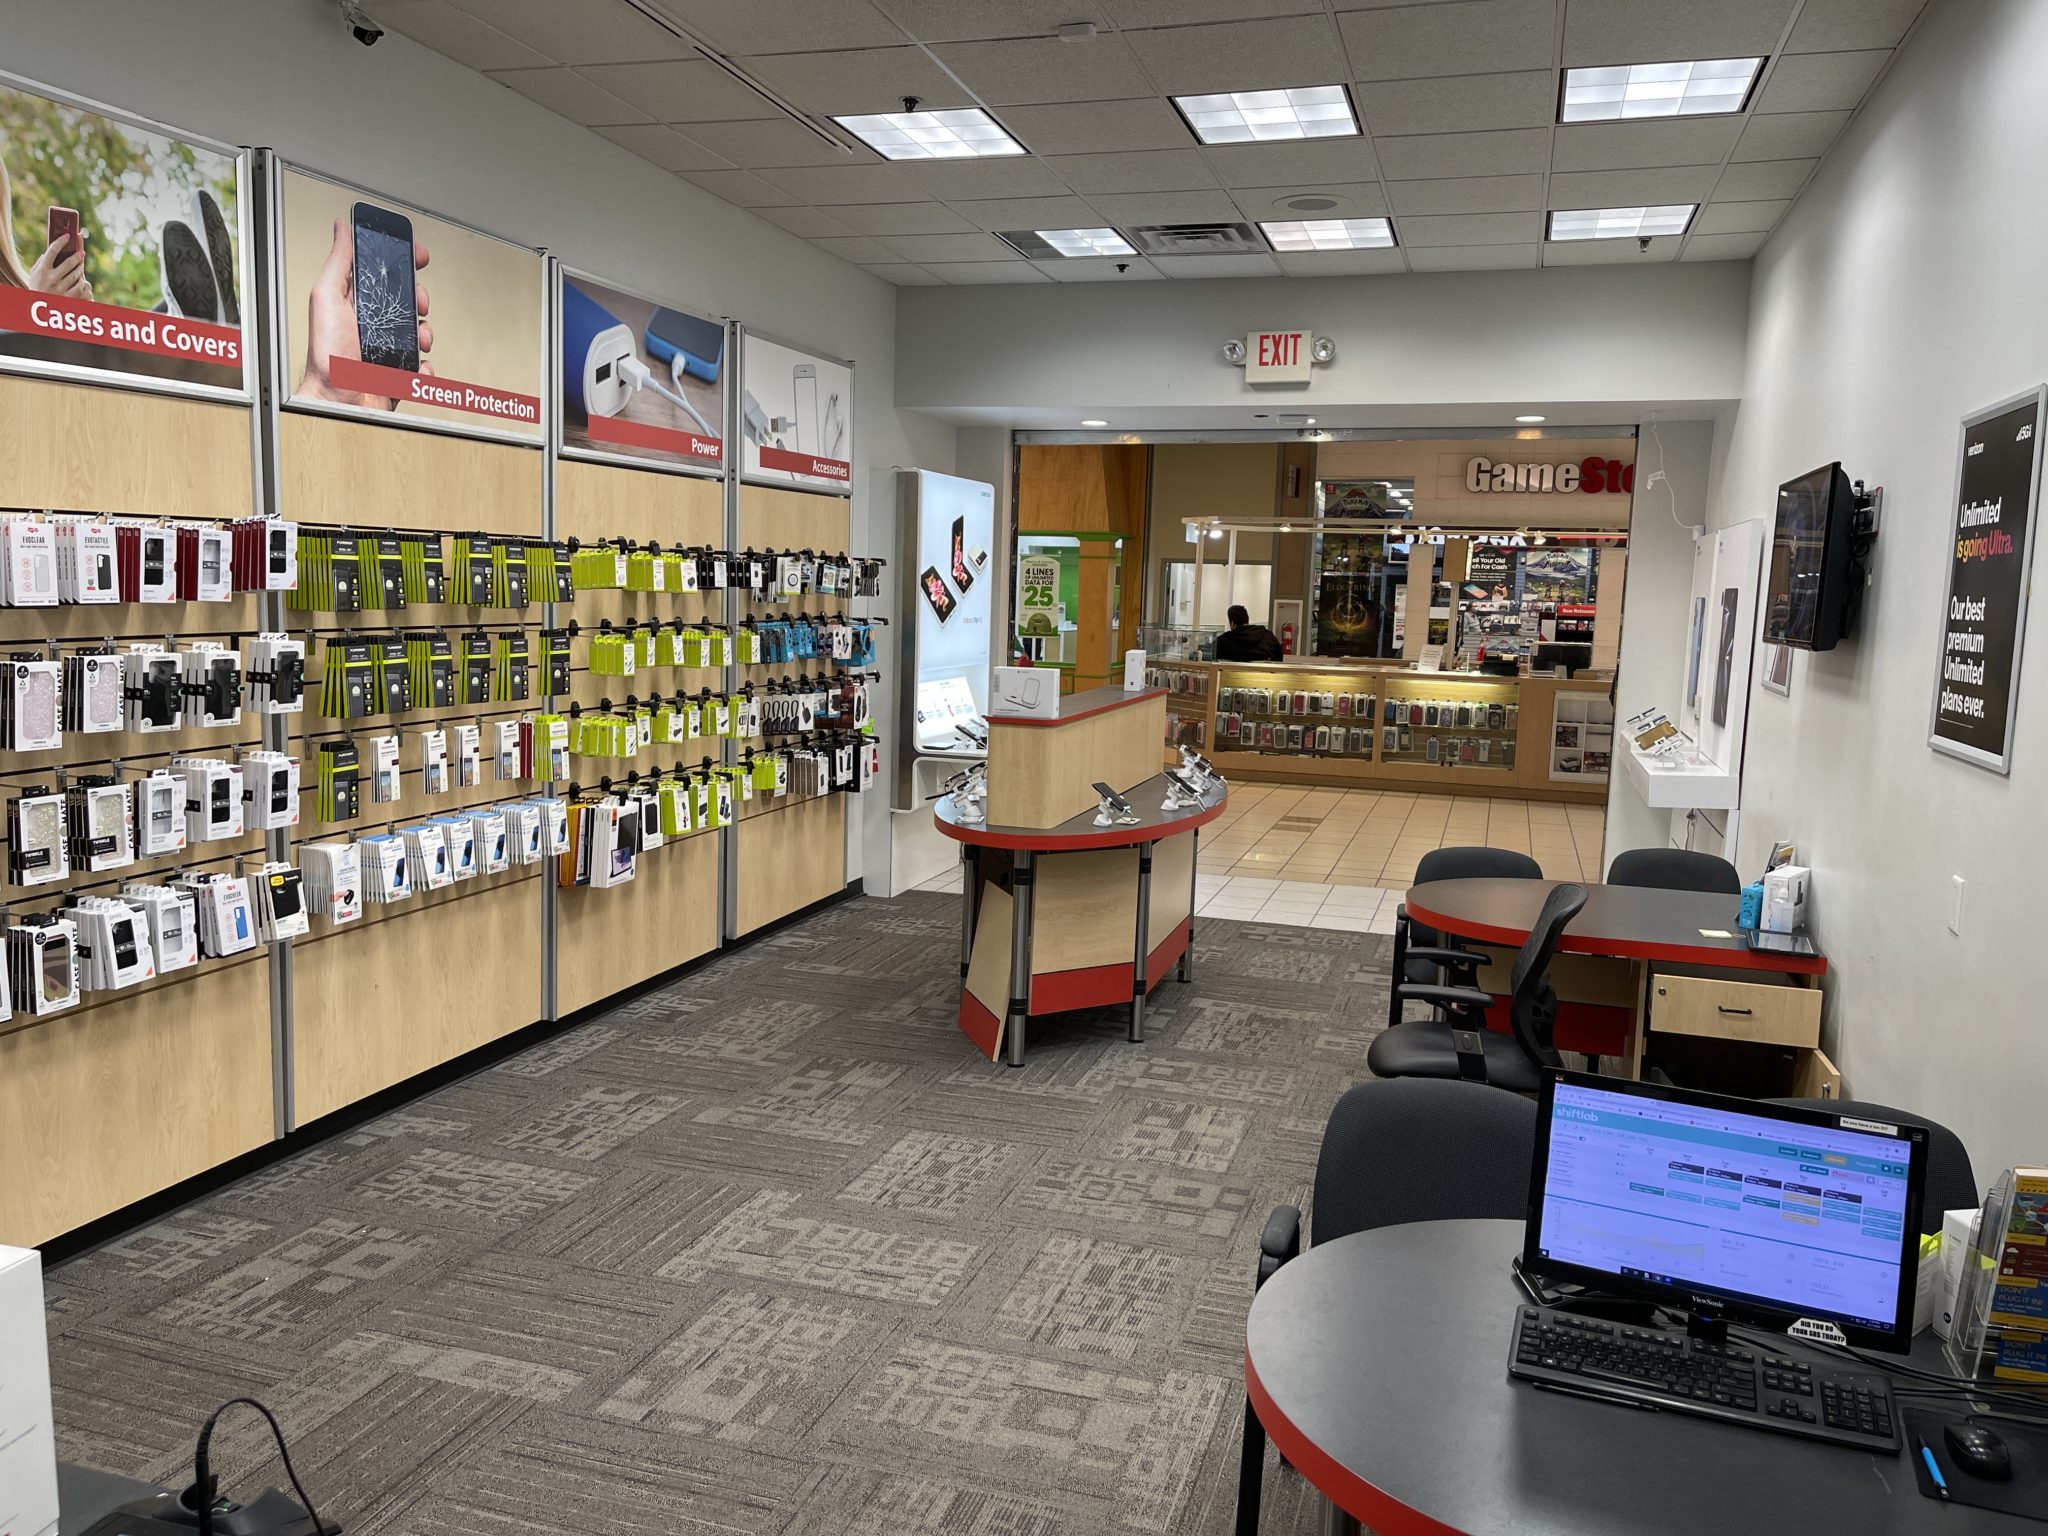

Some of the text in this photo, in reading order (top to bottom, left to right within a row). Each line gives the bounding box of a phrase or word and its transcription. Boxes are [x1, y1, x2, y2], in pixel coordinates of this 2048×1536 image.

[30, 300, 238, 359] Cases and Covers
[1258, 333, 1303, 367] EXIT
[411, 379, 535, 420] Screen Protection
[691, 437, 719, 457] Power
[1967, 441, 1984, 457] verizon
[812, 459, 848, 478] Accessories
[1960, 496, 2002, 528] Unlimited
[1956, 529, 2013, 563] is going Ultra.
[1032, 568, 1054, 576] LINES
[1950, 595, 1986, 621] Our best
[1946, 627, 1984, 654] premium
[1944, 655, 1985, 685] Unlimited
[1940, 685, 1985, 719] plans ever.
[1556, 1107, 1599, 1122] shiftlab
[1692, 1295, 1724, 1309] ViewSonic
[1792, 1327, 1808, 1337] YOUR
[1822, 1332, 1845, 1343] TODAY?
[1800, 1320, 1811, 1328] DID
[1812, 1322, 1824, 1330] YOU
